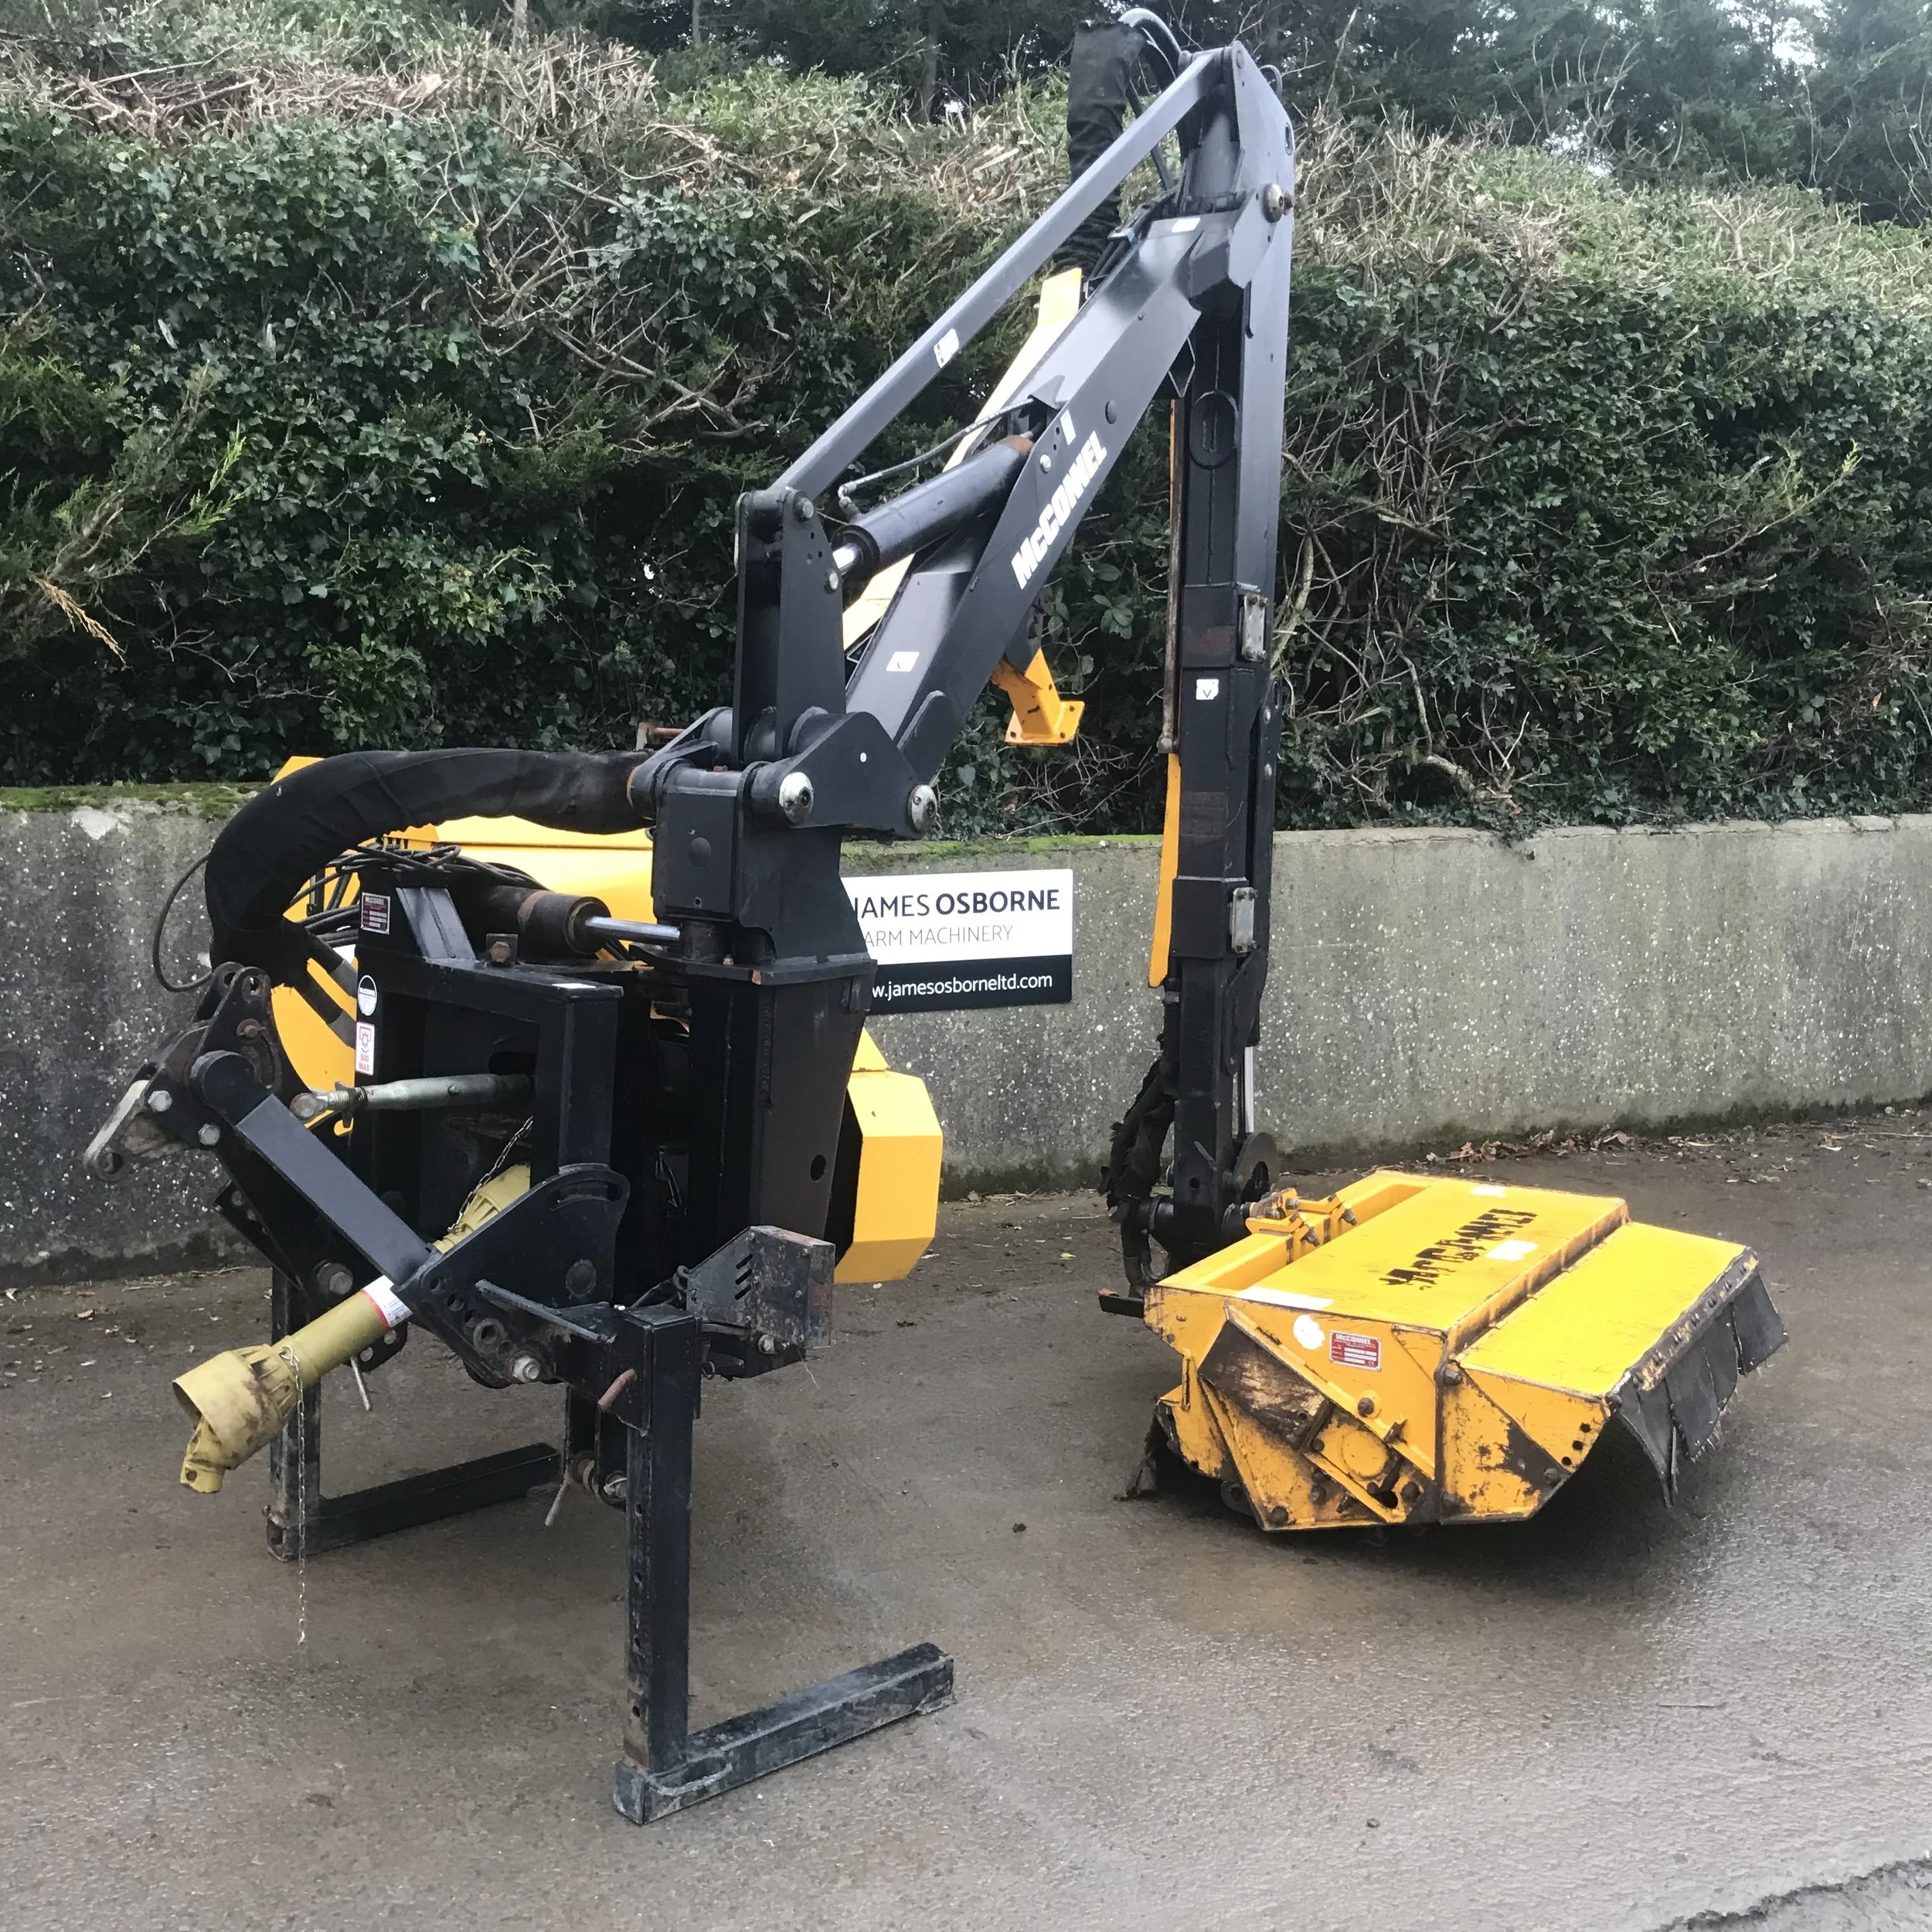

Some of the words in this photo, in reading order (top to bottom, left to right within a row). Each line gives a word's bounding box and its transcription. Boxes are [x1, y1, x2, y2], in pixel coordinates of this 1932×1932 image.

[936, 889, 1060, 915] OSBORNE
[864, 930, 902, 947] ARM
[910, 924, 1013, 946] MACHINERY
[872, 973, 1053, 1002] w.jamesosborneltd.com
